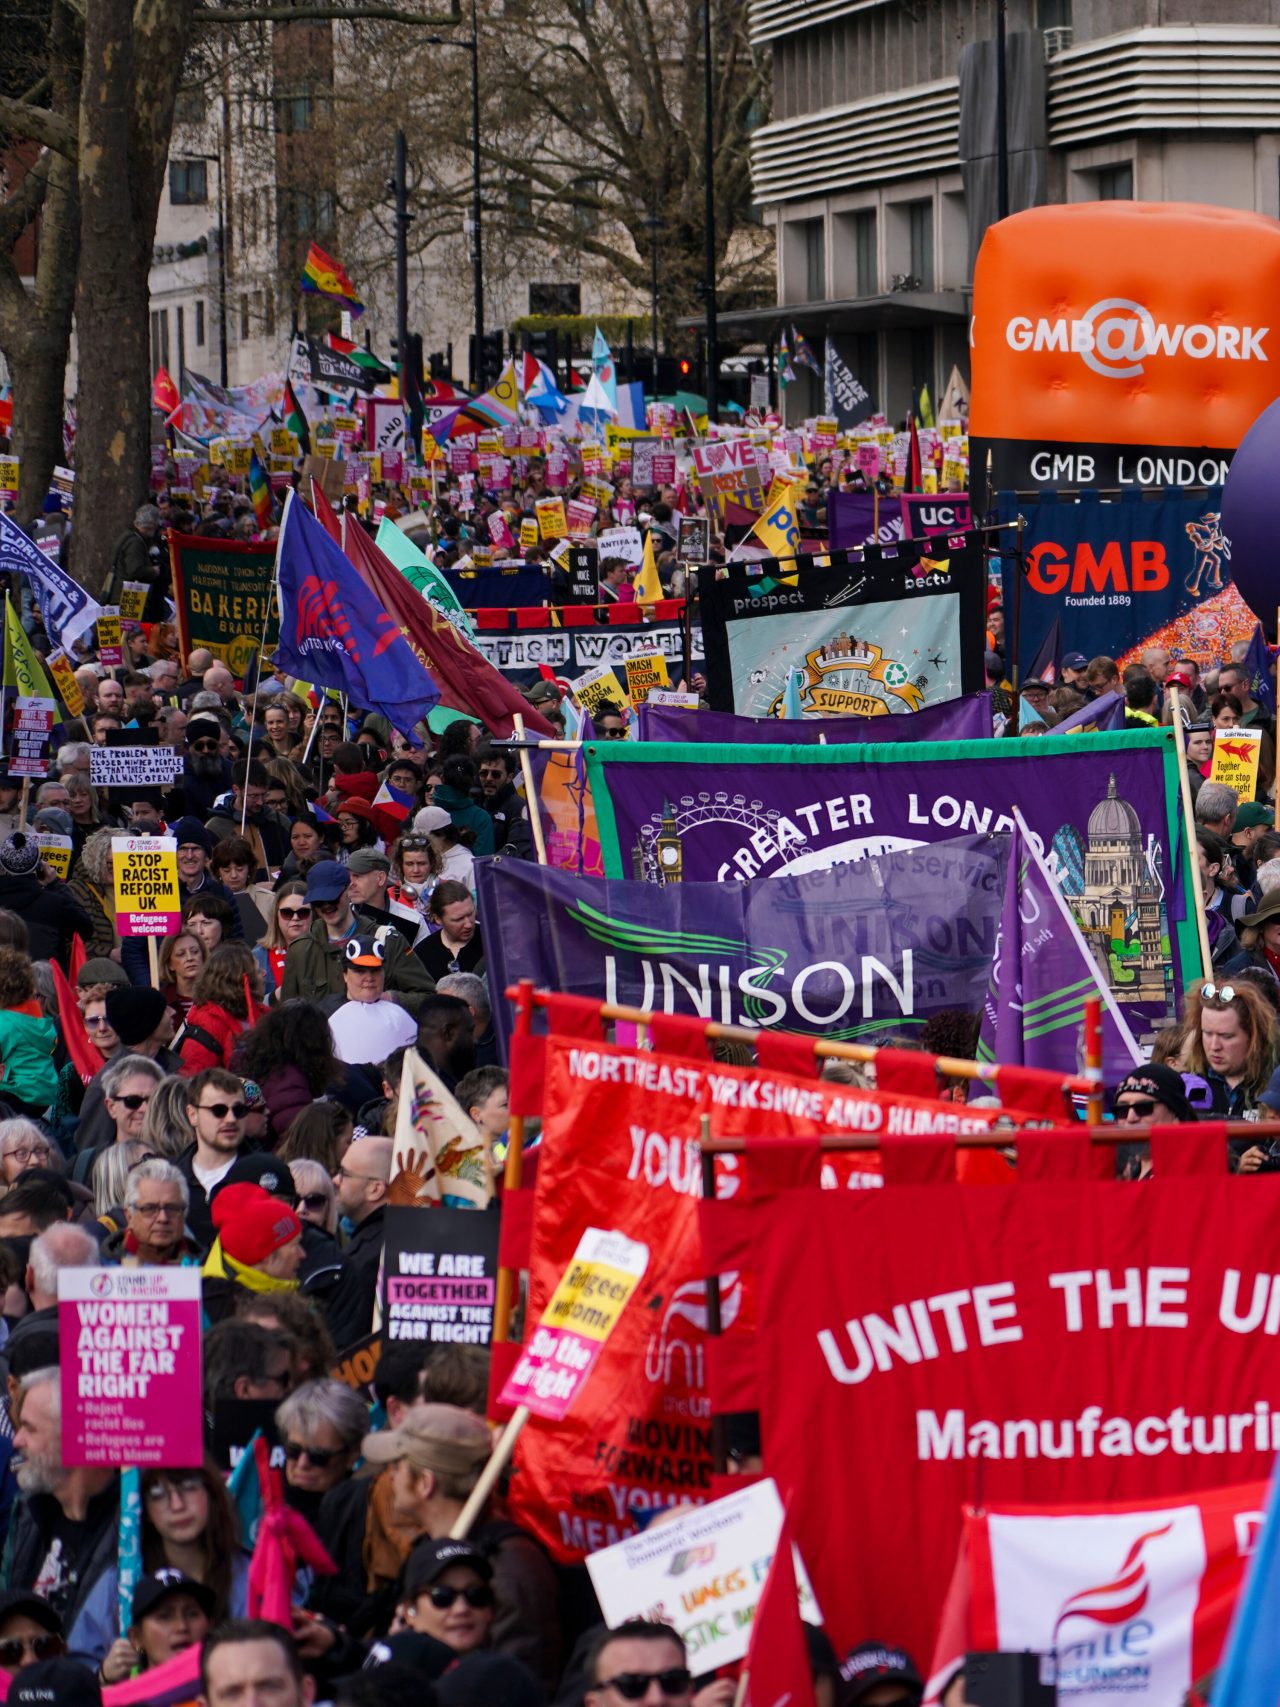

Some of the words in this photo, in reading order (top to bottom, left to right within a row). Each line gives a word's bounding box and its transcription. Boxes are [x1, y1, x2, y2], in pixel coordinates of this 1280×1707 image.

[1006, 298, 1270, 379] GMB@WORK
[693, 440, 755, 474] LVE
[1030, 452, 1096, 482] GMB
[578, 556, 588, 567] OUR
[1026, 541, 1171, 595] GMB
[572, 584, 595, 596] MATTERS
[904, 573, 951, 590] bectu
[733, 590, 804, 614] prospect
[1065, 596, 1106, 607] Founded
[1108, 596, 1132, 607] 1889
[626, 660, 652, 672] SMASH
[629, 673, 661, 686] FASCISM
[820, 692, 878, 714] SUPPORT
[110, 750, 148, 758] PROBLEM
[152, 748, 172, 756] WITH
[126, 766, 146, 774] THEIR
[150, 766, 182, 774] MOUTHS
[154, 758, 182, 766] PEOPLE
[1217, 760, 1240, 773] Together
[92, 776, 108, 784] ARE
[1236, 773, 1250, 782] stop
[717, 793, 873, 894] GREATER
[128, 854, 162, 867] STOP
[122, 869, 168, 881] RACIST
[120, 883, 173, 896] REFORM
[138, 896, 157, 910] UK
[129, 914, 168, 925] Refugees
[131, 924, 168, 934] welcome
[606, 948, 915, 1028] UNISON
[399, 1253, 434, 1276] WE
[439, 1255, 485, 1277] ARE
[393, 1282, 489, 1299] TOGETHER
[78, 1304, 168, 1326] WOMEN
[389, 1304, 456, 1322] AGAINST
[459, 1306, 492, 1323] THE
[388, 1322, 428, 1340] FAR
[432, 1324, 491, 1344] RIGHT
[817, 1281, 1023, 1385] UNITE
[1049, 1266, 1190, 1332] THE
[78, 1326, 184, 1350] AGAINST
[78, 1351, 121, 1374] THE
[130, 1351, 174, 1374] FAR
[78, 1376, 150, 1398] RIGHT
